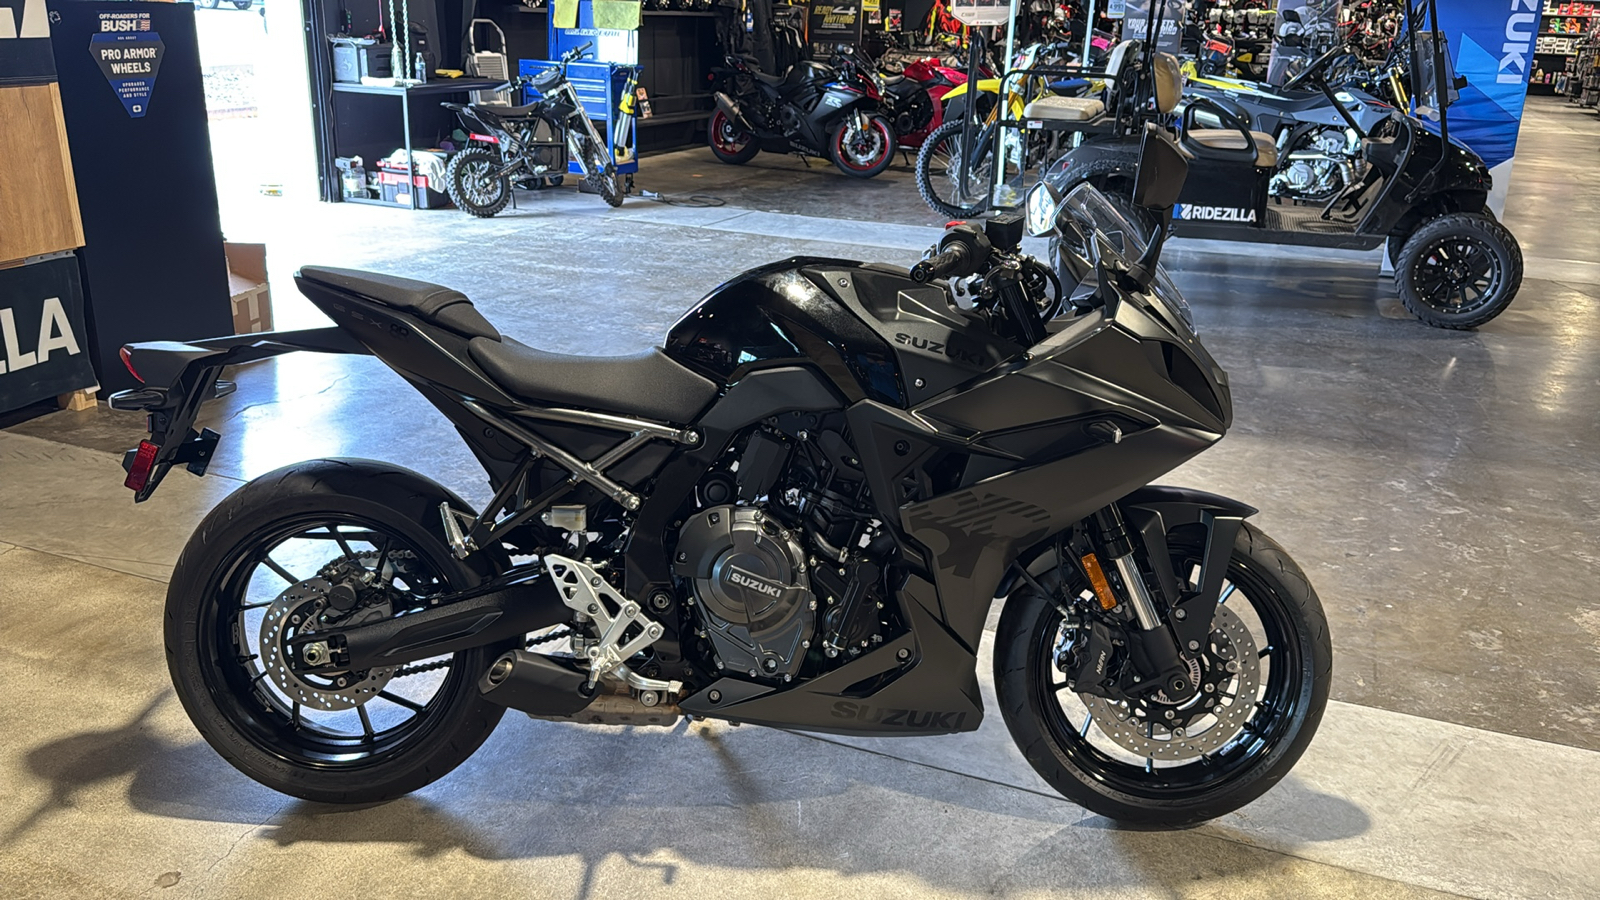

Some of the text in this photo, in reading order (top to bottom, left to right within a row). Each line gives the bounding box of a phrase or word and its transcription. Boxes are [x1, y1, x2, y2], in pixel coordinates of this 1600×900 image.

[101, 20, 136, 31] BUSH
[101, 47, 157, 60] PRO ARMOR
[110, 61, 151, 74] WHEELS
[1192, 205, 1257, 222] RIDEZILLA
[730, 572, 782, 598] SUZUKI
[830, 701, 966, 729] SUZUKI
